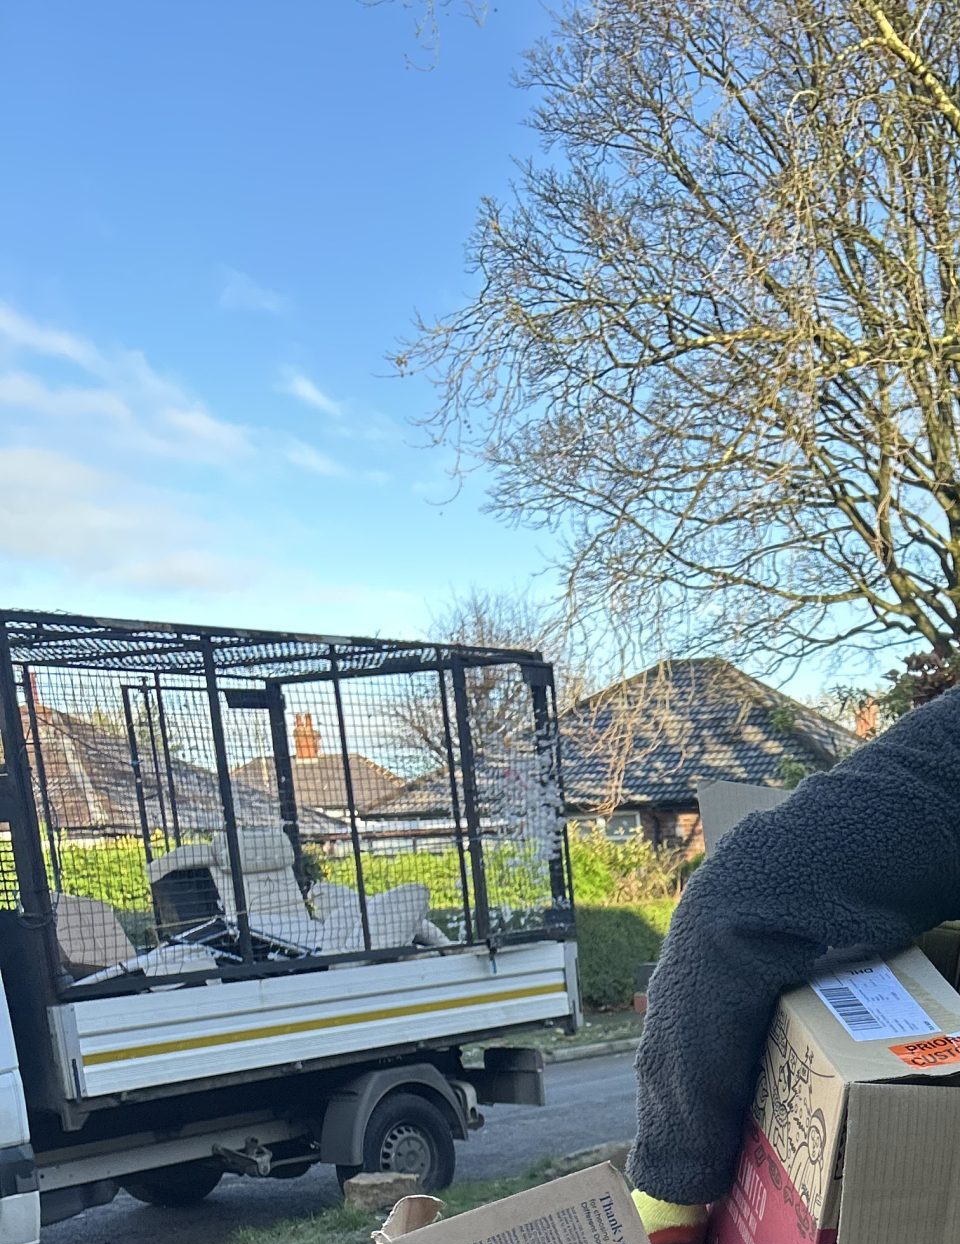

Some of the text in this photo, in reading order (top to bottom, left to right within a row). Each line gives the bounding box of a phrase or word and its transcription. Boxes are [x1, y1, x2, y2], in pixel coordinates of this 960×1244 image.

[581, 1201, 597, 1233] Different
[589, 1198, 610, 1241] for choosing
[599, 1191, 623, 1235] Thank
